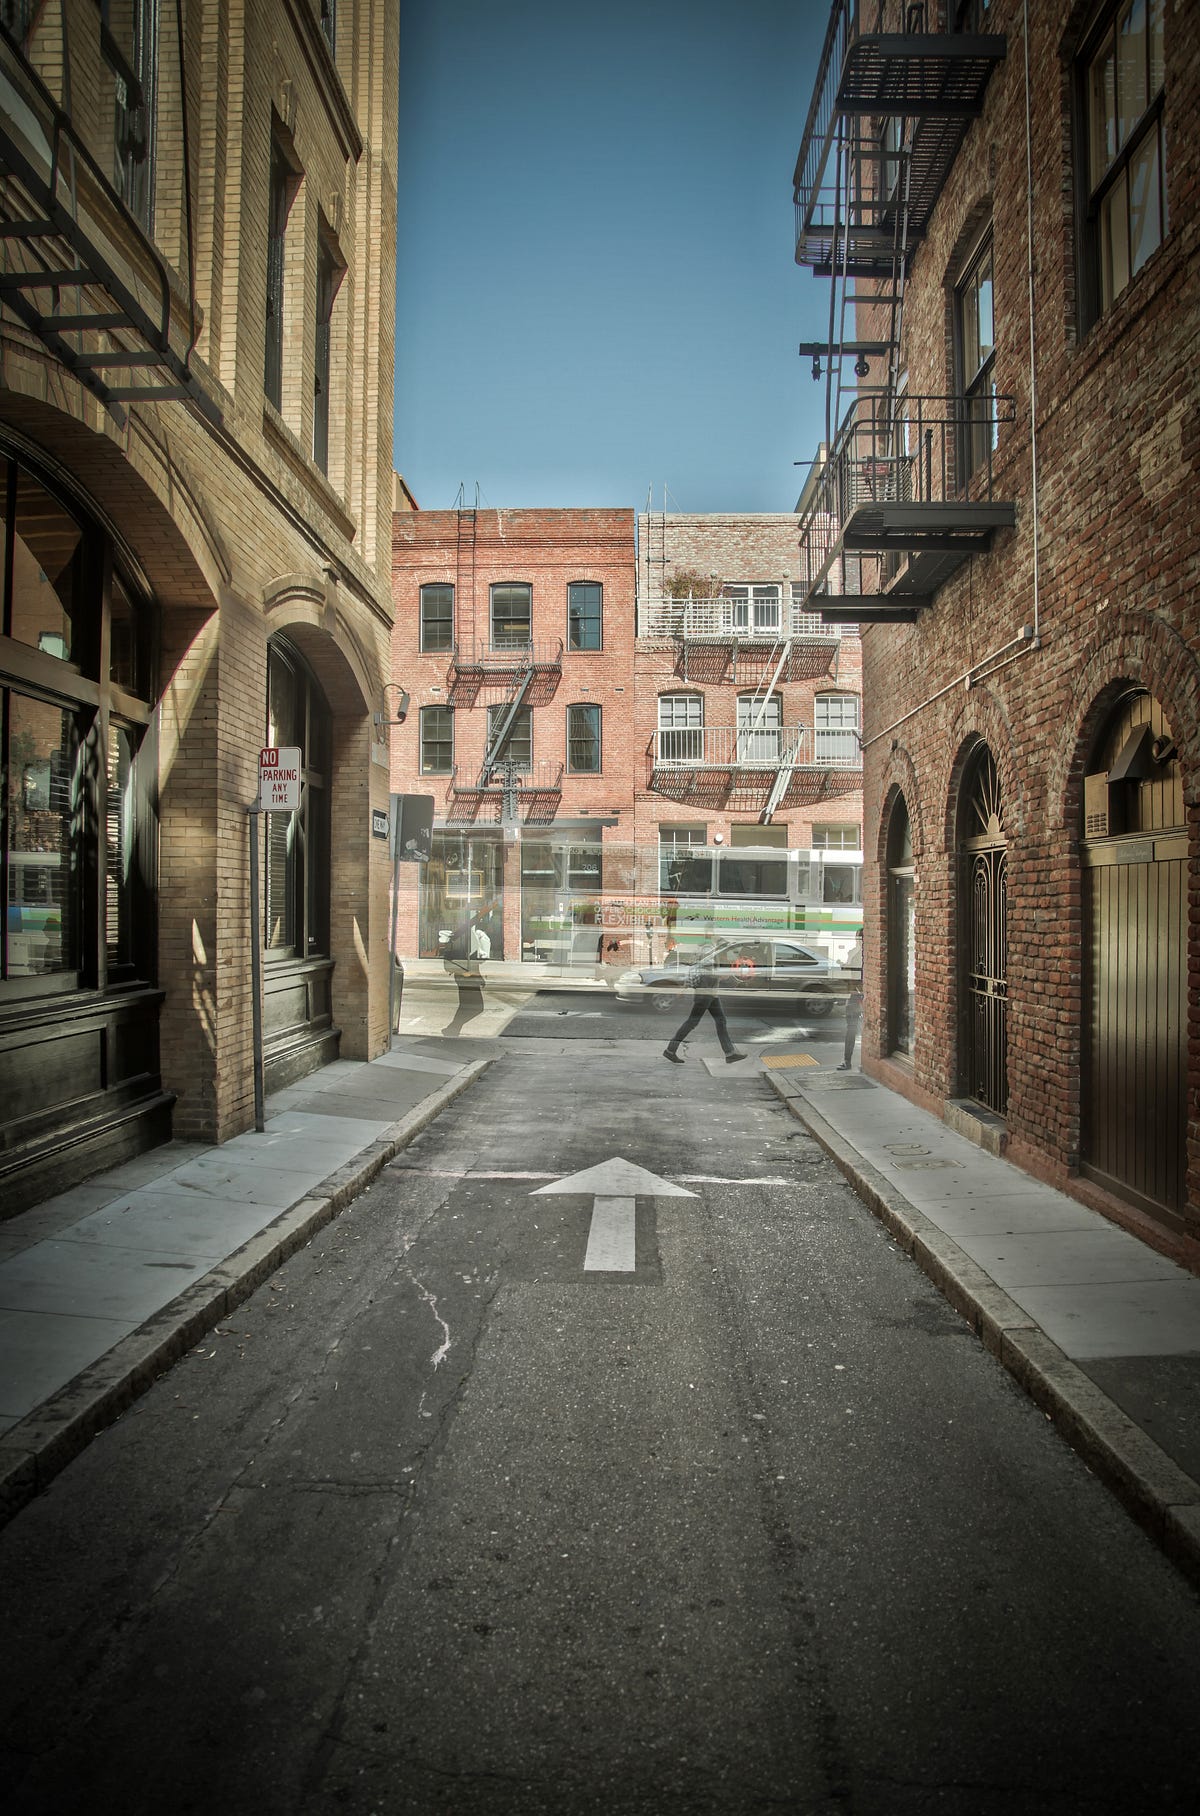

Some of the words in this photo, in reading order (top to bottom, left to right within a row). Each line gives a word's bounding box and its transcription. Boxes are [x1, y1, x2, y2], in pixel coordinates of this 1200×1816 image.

[262, 751, 277, 765] NO
[263, 769, 297, 781] PARKING
[272, 783, 288, 792] ANY
[271, 794, 288, 803] TIME
[594, 906, 625, 914] OFFERS
[625, 907, 661, 915] CHOICES
[594, 913, 669, 926] FLEXIBILITY
[703, 914, 730, 922] Western
[731, 915, 751, 923] Health
[752, 916, 785, 924] Advantage
